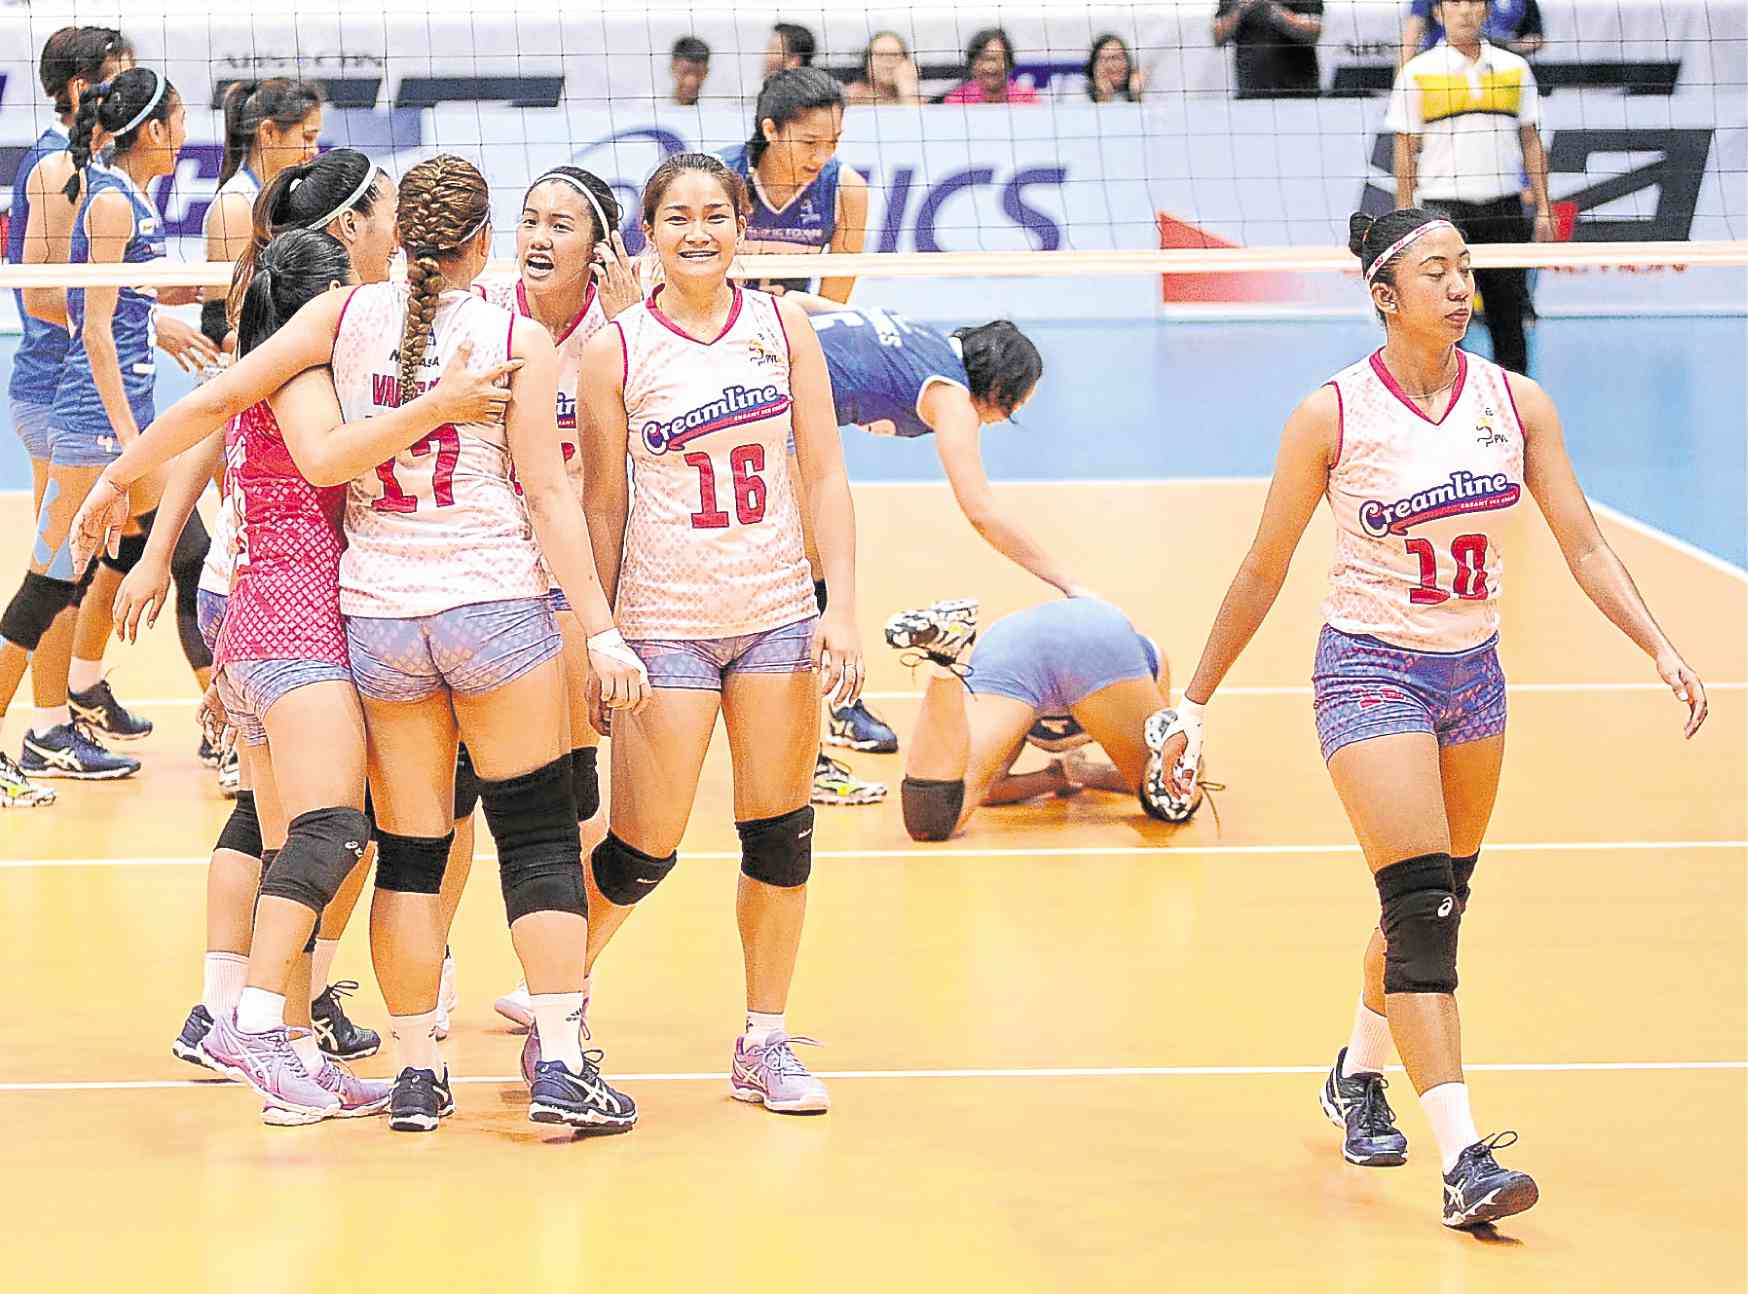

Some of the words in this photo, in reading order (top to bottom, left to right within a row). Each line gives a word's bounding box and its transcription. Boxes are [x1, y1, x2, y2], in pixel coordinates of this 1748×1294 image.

[858, 168, 1067, 252] ICS
[642, 385, 779, 455] Creamline
[371, 423, 460, 513] 17
[684, 444, 766, 528] 16
[1359, 471, 1508, 537] Creamline
[1405, 534, 1488, 604] 10
